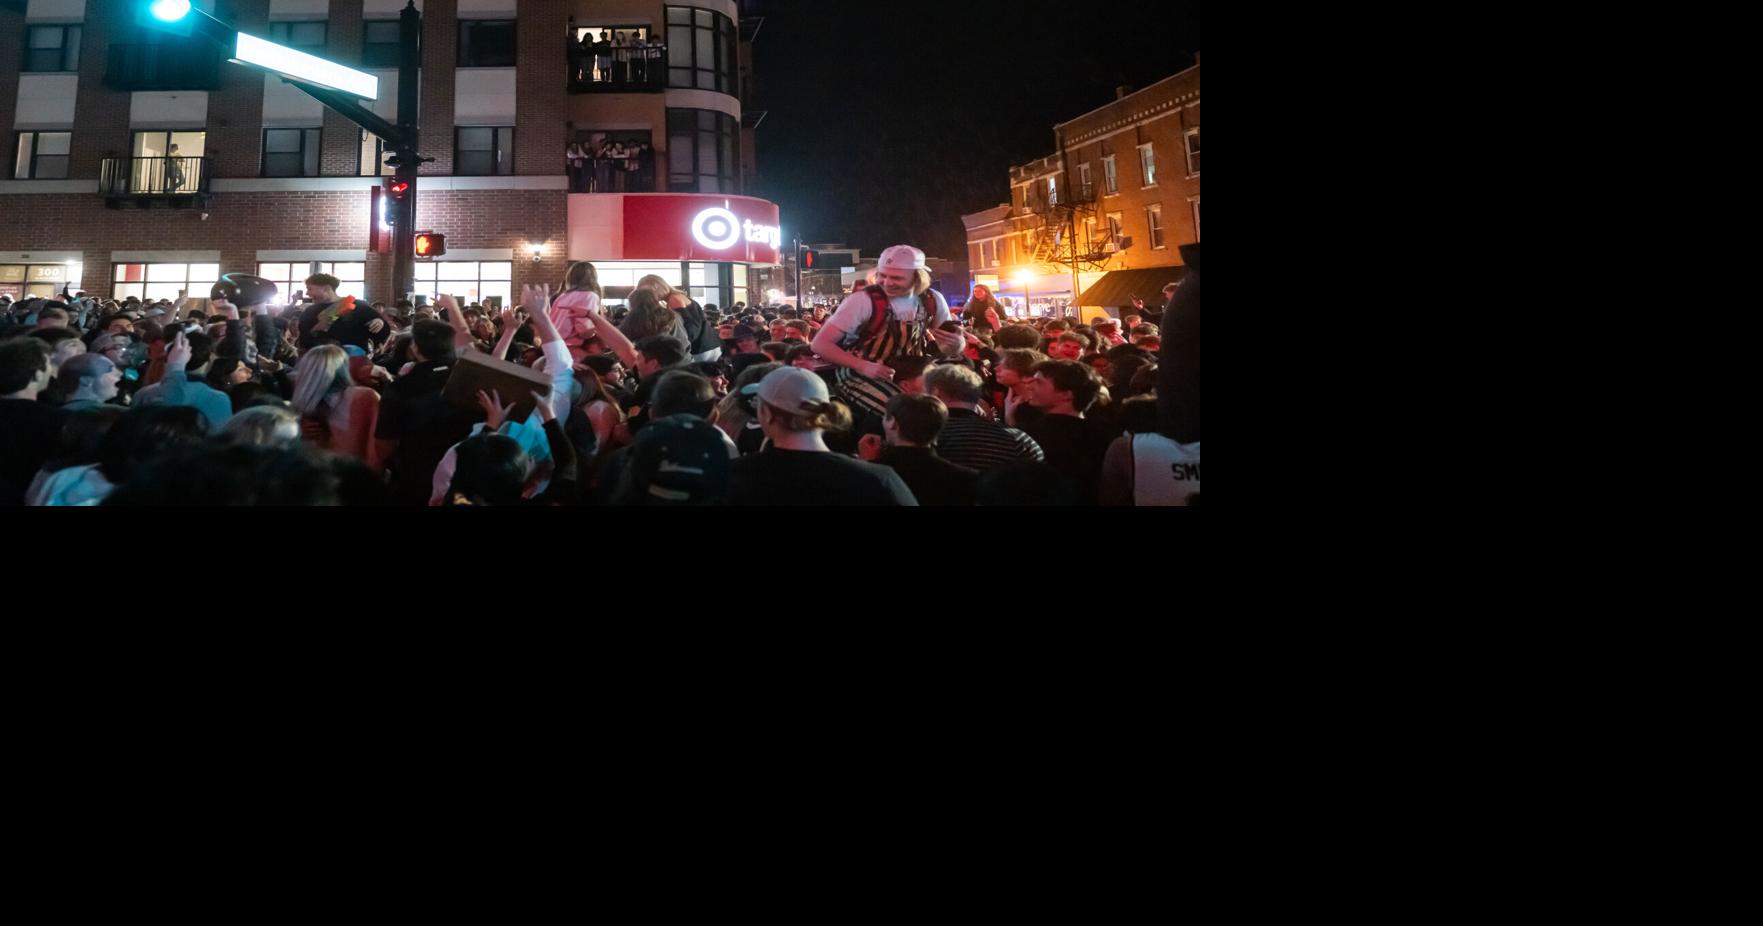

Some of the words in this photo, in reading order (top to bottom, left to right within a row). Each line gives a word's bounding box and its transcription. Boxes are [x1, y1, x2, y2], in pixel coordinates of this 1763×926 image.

[743, 219, 780, 250] targ
[37, 268, 60, 277] 300
[1171, 463, 1200, 481] SM
